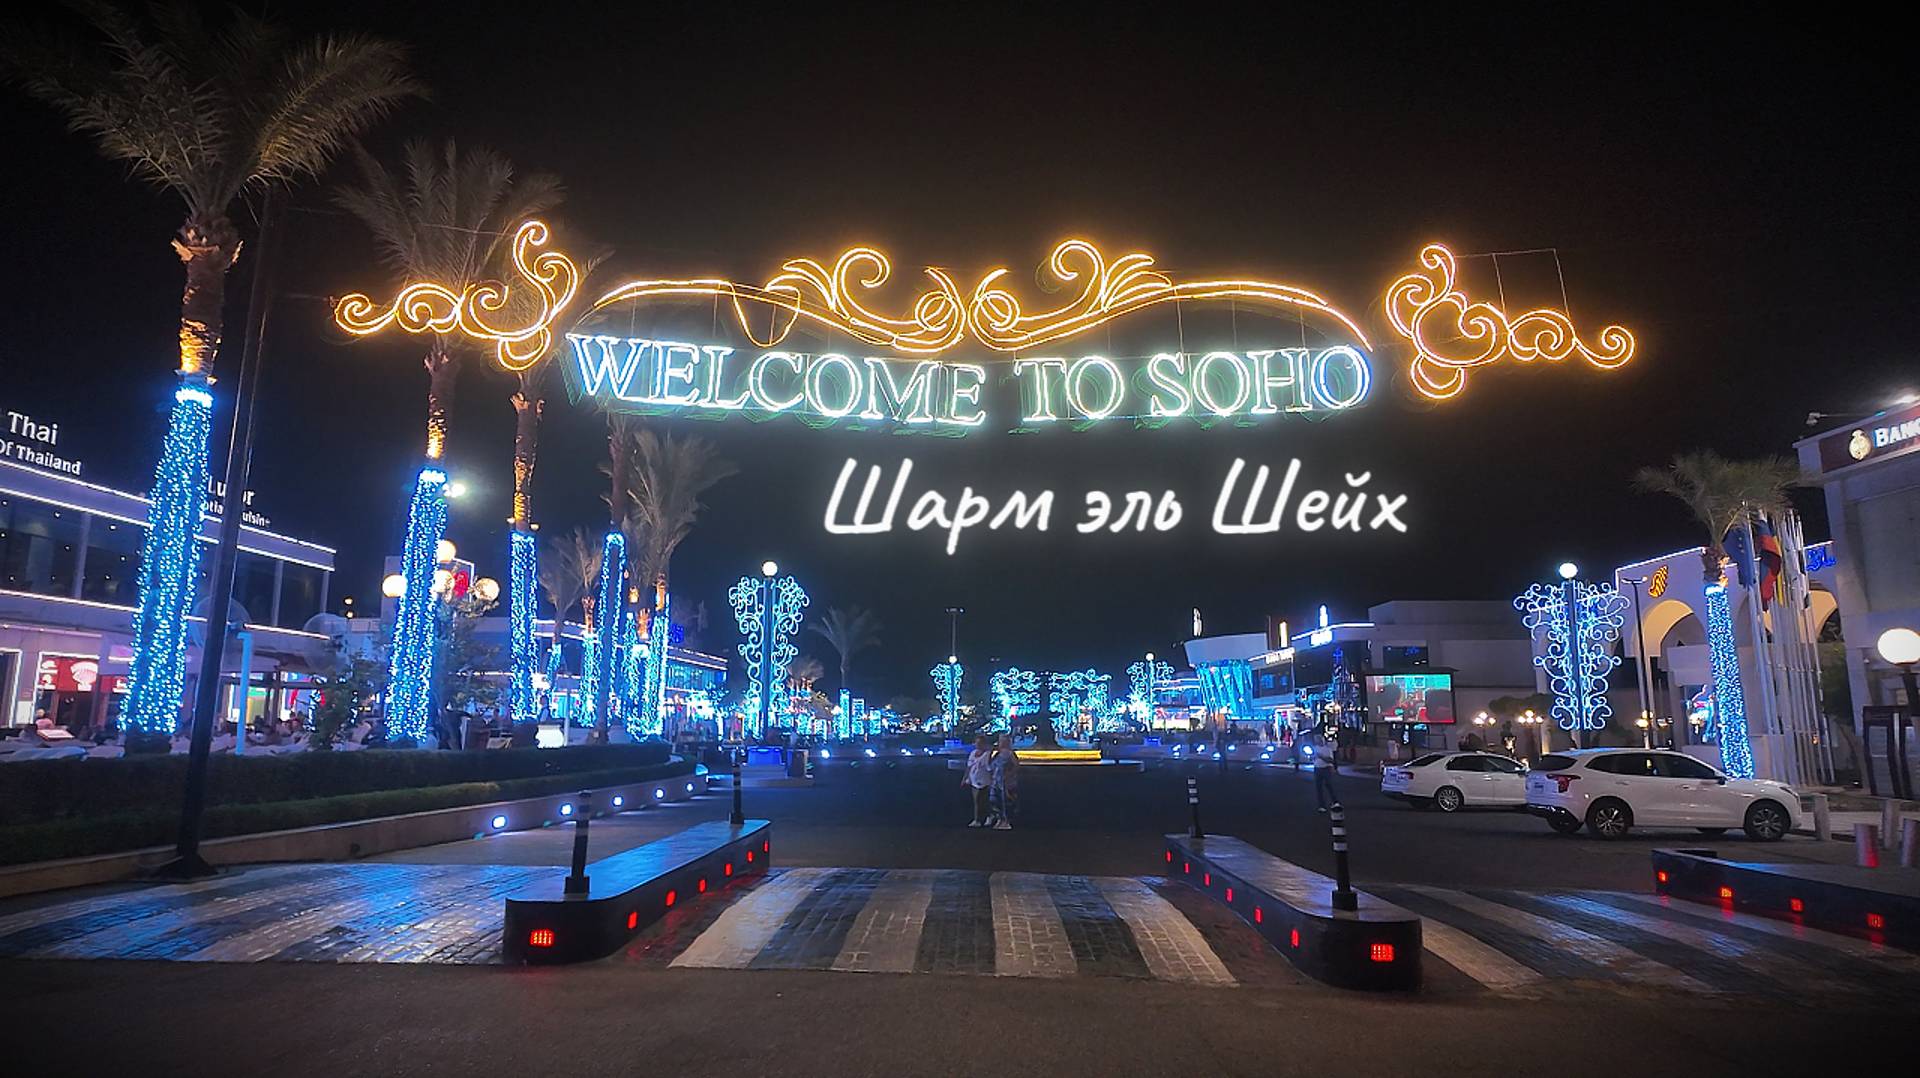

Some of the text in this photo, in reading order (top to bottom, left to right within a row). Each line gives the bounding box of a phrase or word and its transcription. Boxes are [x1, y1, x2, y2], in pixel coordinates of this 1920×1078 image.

[565, 332, 1371, 426] WELCOME TO SOHO
[7, 411, 58, 445] Thai
[16, 444, 82, 475] Thailand
